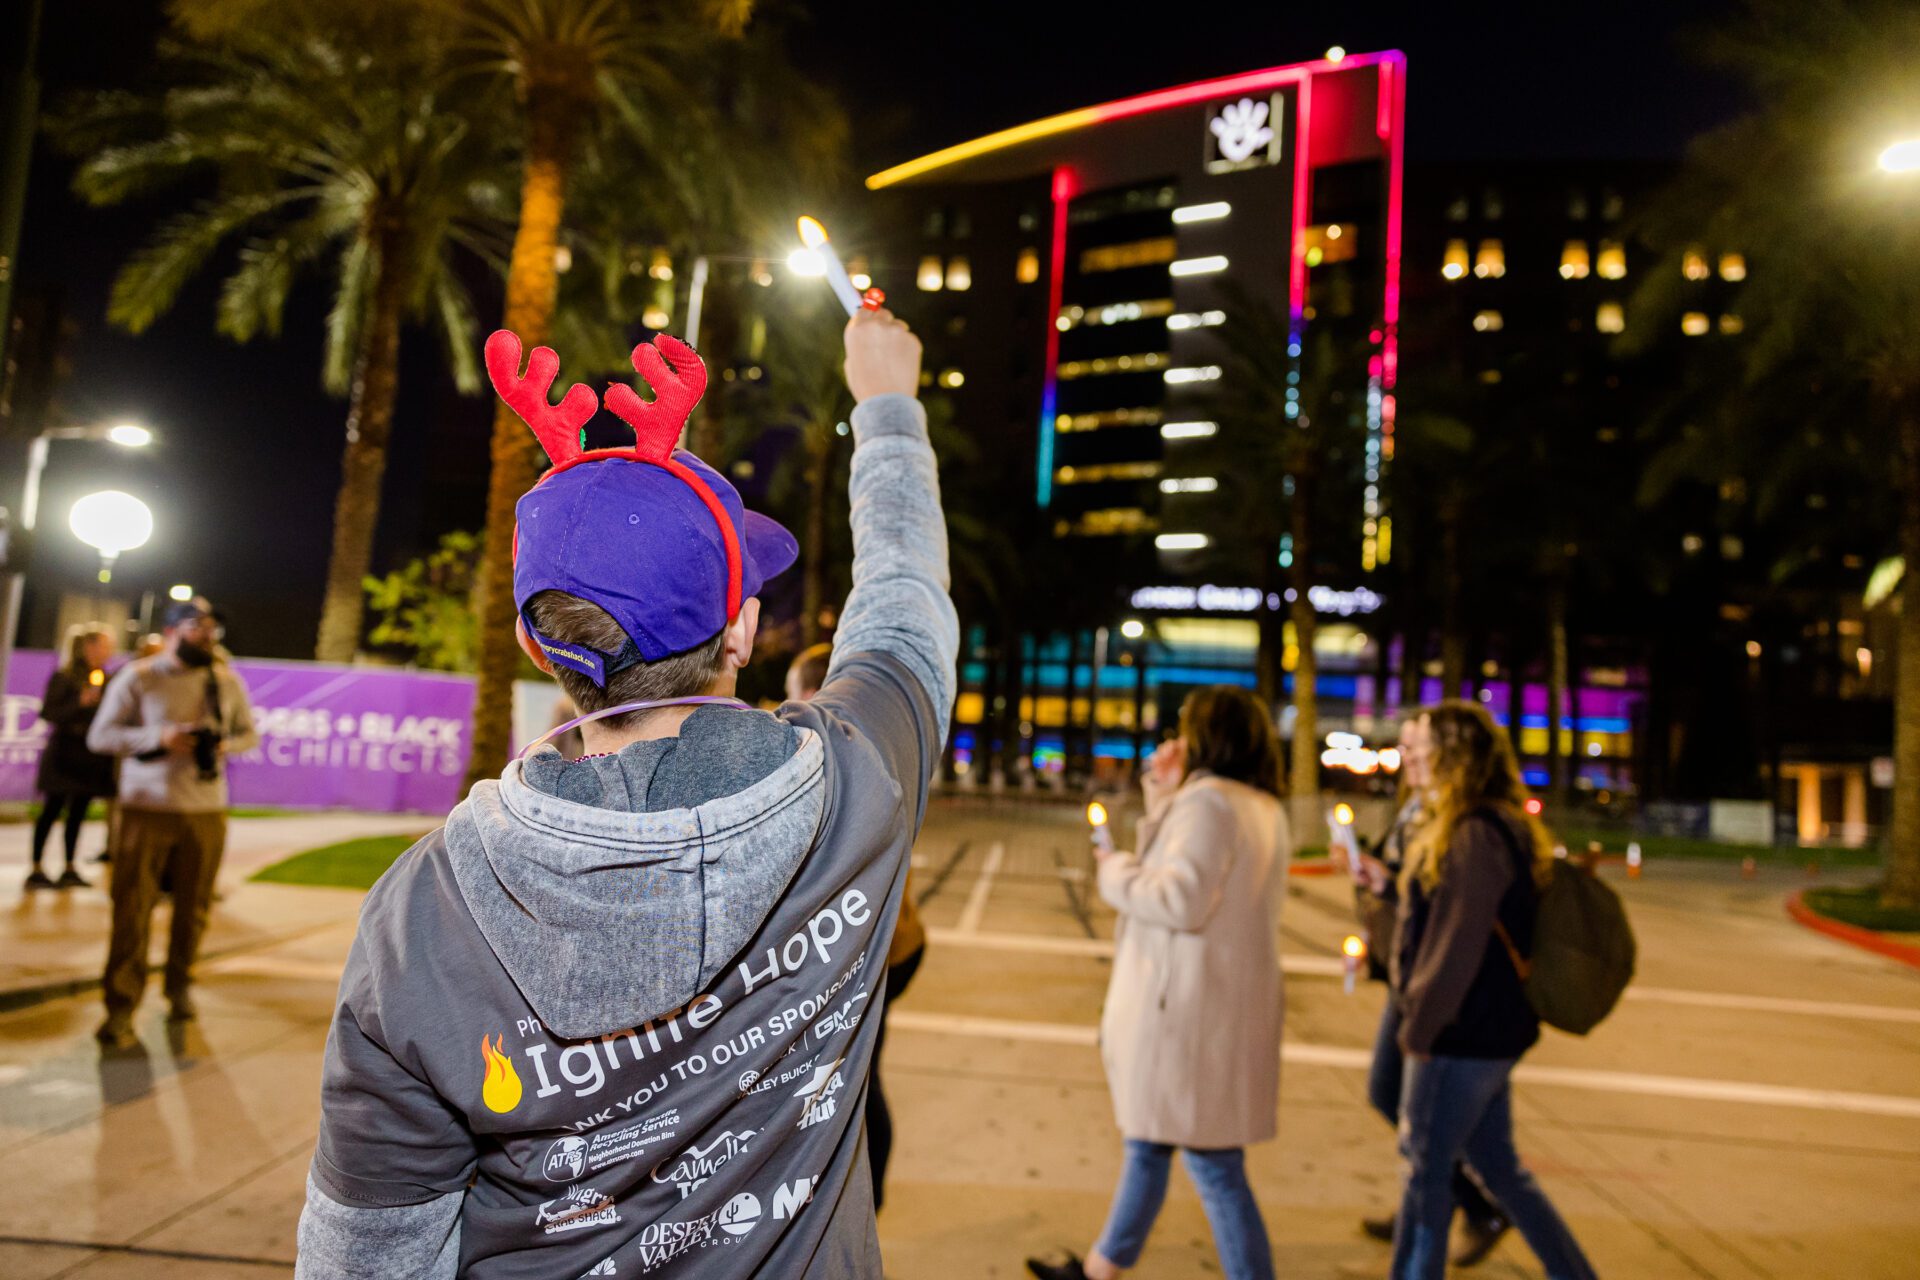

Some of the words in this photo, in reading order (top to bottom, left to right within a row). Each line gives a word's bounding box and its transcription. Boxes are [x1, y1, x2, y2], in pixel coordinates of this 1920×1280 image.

[359, 711, 463, 748] BLACK
[526, 993, 723, 1099] Ignite
[737, 888, 871, 995] Hope
[616, 1071, 669, 1112] YOU
[670, 1054, 707, 1081] TO
[711, 1026, 766, 1065] OUR
[768, 952, 865, 1036] SPONSORS
[781, 1059, 813, 1084] BUICK
[796, 1096, 837, 1131] Hut
[588, 1142, 631, 1164] Neighborhood
[631, 1134, 661, 1149] Donation
[661, 1131, 676, 1141] Bins
[590, 1129, 639, 1152] Recycling
[641, 1114, 680, 1134] Service
[593, 1121, 642, 1143] American
[547, 1147, 585, 1171] ATRS
[578, 1208, 613, 1223] SHACK
[639, 1221, 718, 1267] VALLEY
[700, 1234, 747, 1248] GROU
